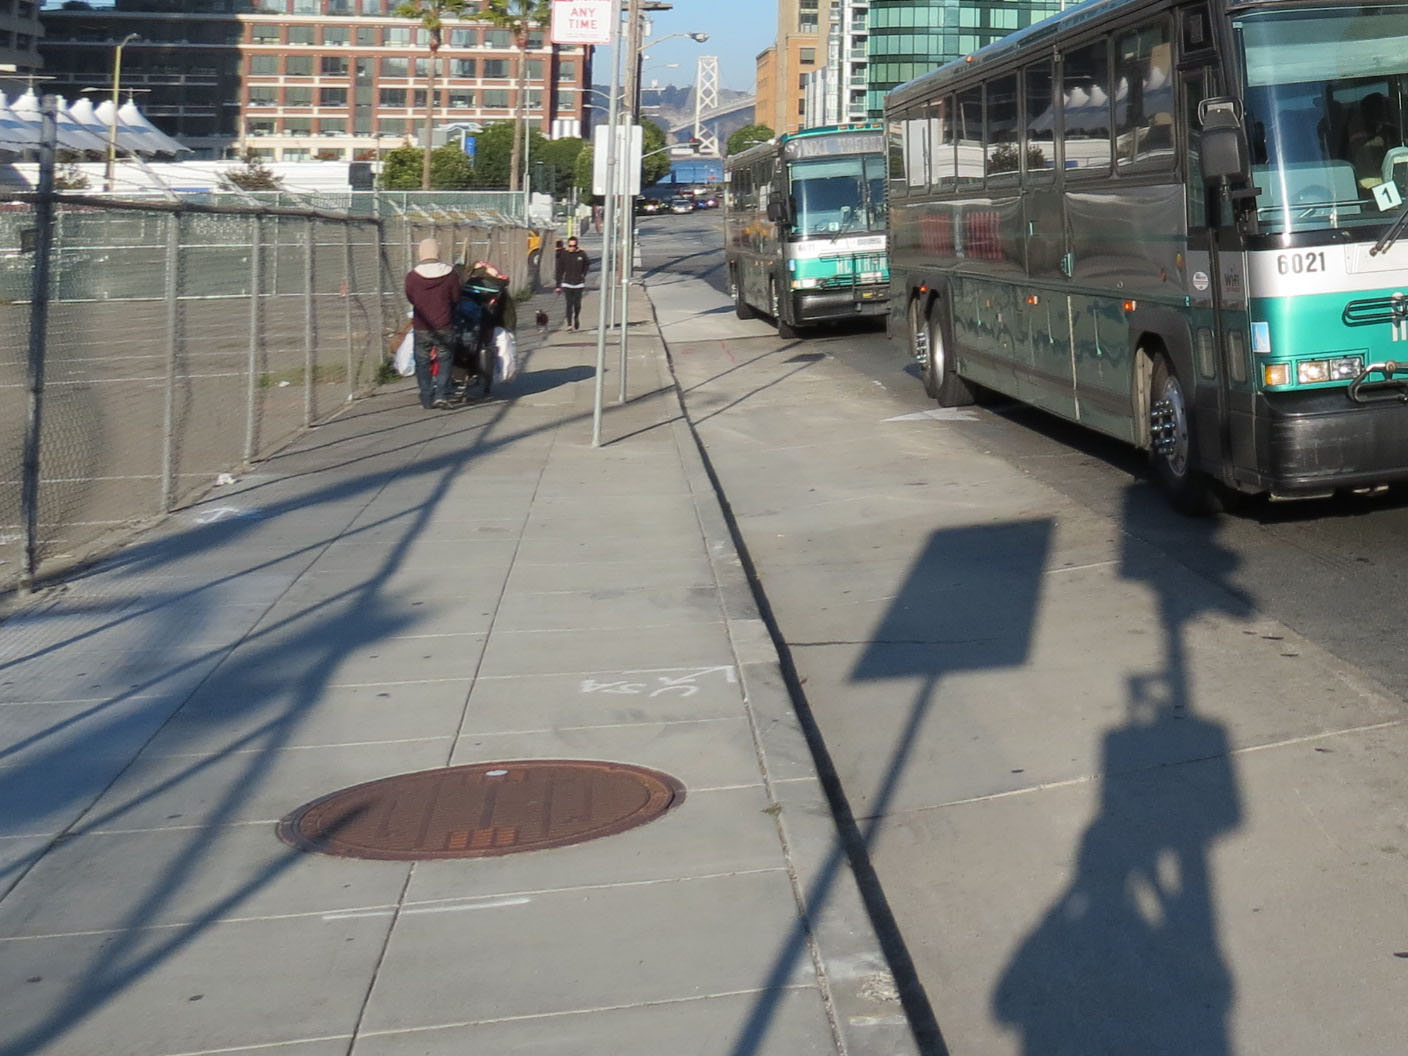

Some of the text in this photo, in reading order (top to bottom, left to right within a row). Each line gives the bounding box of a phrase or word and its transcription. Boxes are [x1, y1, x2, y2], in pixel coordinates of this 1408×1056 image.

[571, 8, 596, 17] ANY
[568, 19, 598, 29] TIME
[1382, 187, 1394, 204] 1
[1277, 252, 1326, 276] 6021
